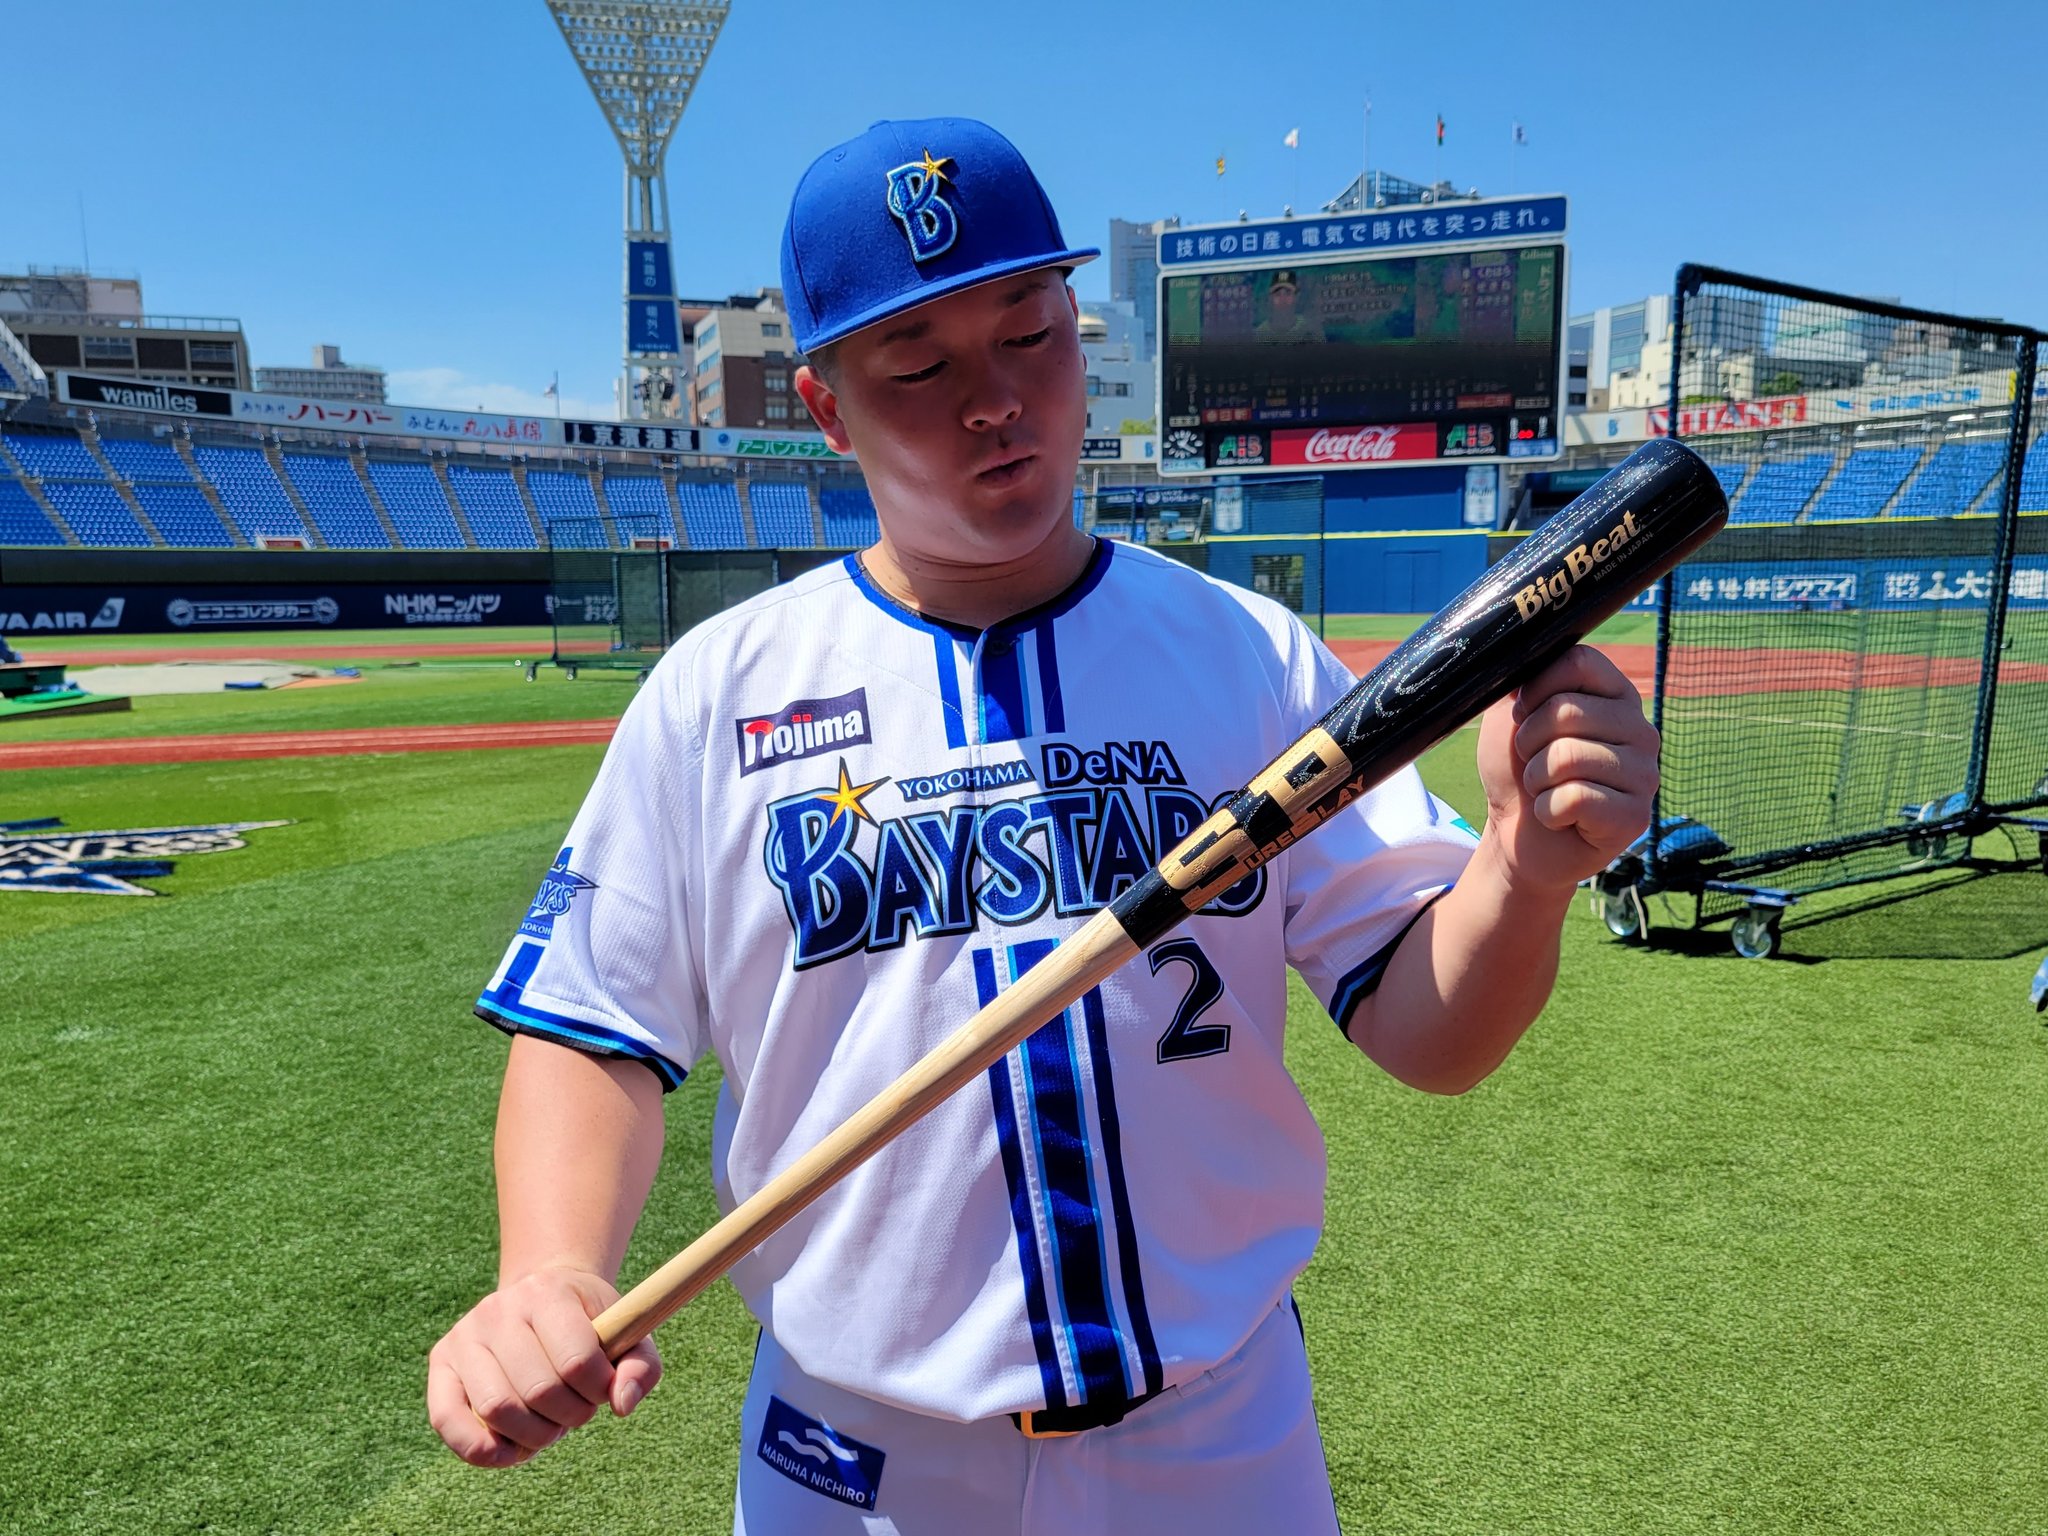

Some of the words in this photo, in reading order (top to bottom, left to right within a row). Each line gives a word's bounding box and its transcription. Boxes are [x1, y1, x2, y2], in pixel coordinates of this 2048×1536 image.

[100, 385, 198, 413] wamiles
[1594, 561, 1617, 582] MADE
[1628, 532, 1654, 557] JAPAN
[197, 605, 311, 620] ニコニコレンタカー
[898, 761, 1033, 801] YOKOHAMA
[1044, 742, 1185, 786] DeNA
[1147, 937, 1232, 1065] 2
[762, 1442, 807, 1481] MARUHA
[810, 1472, 866, 1504] NICHIRO
